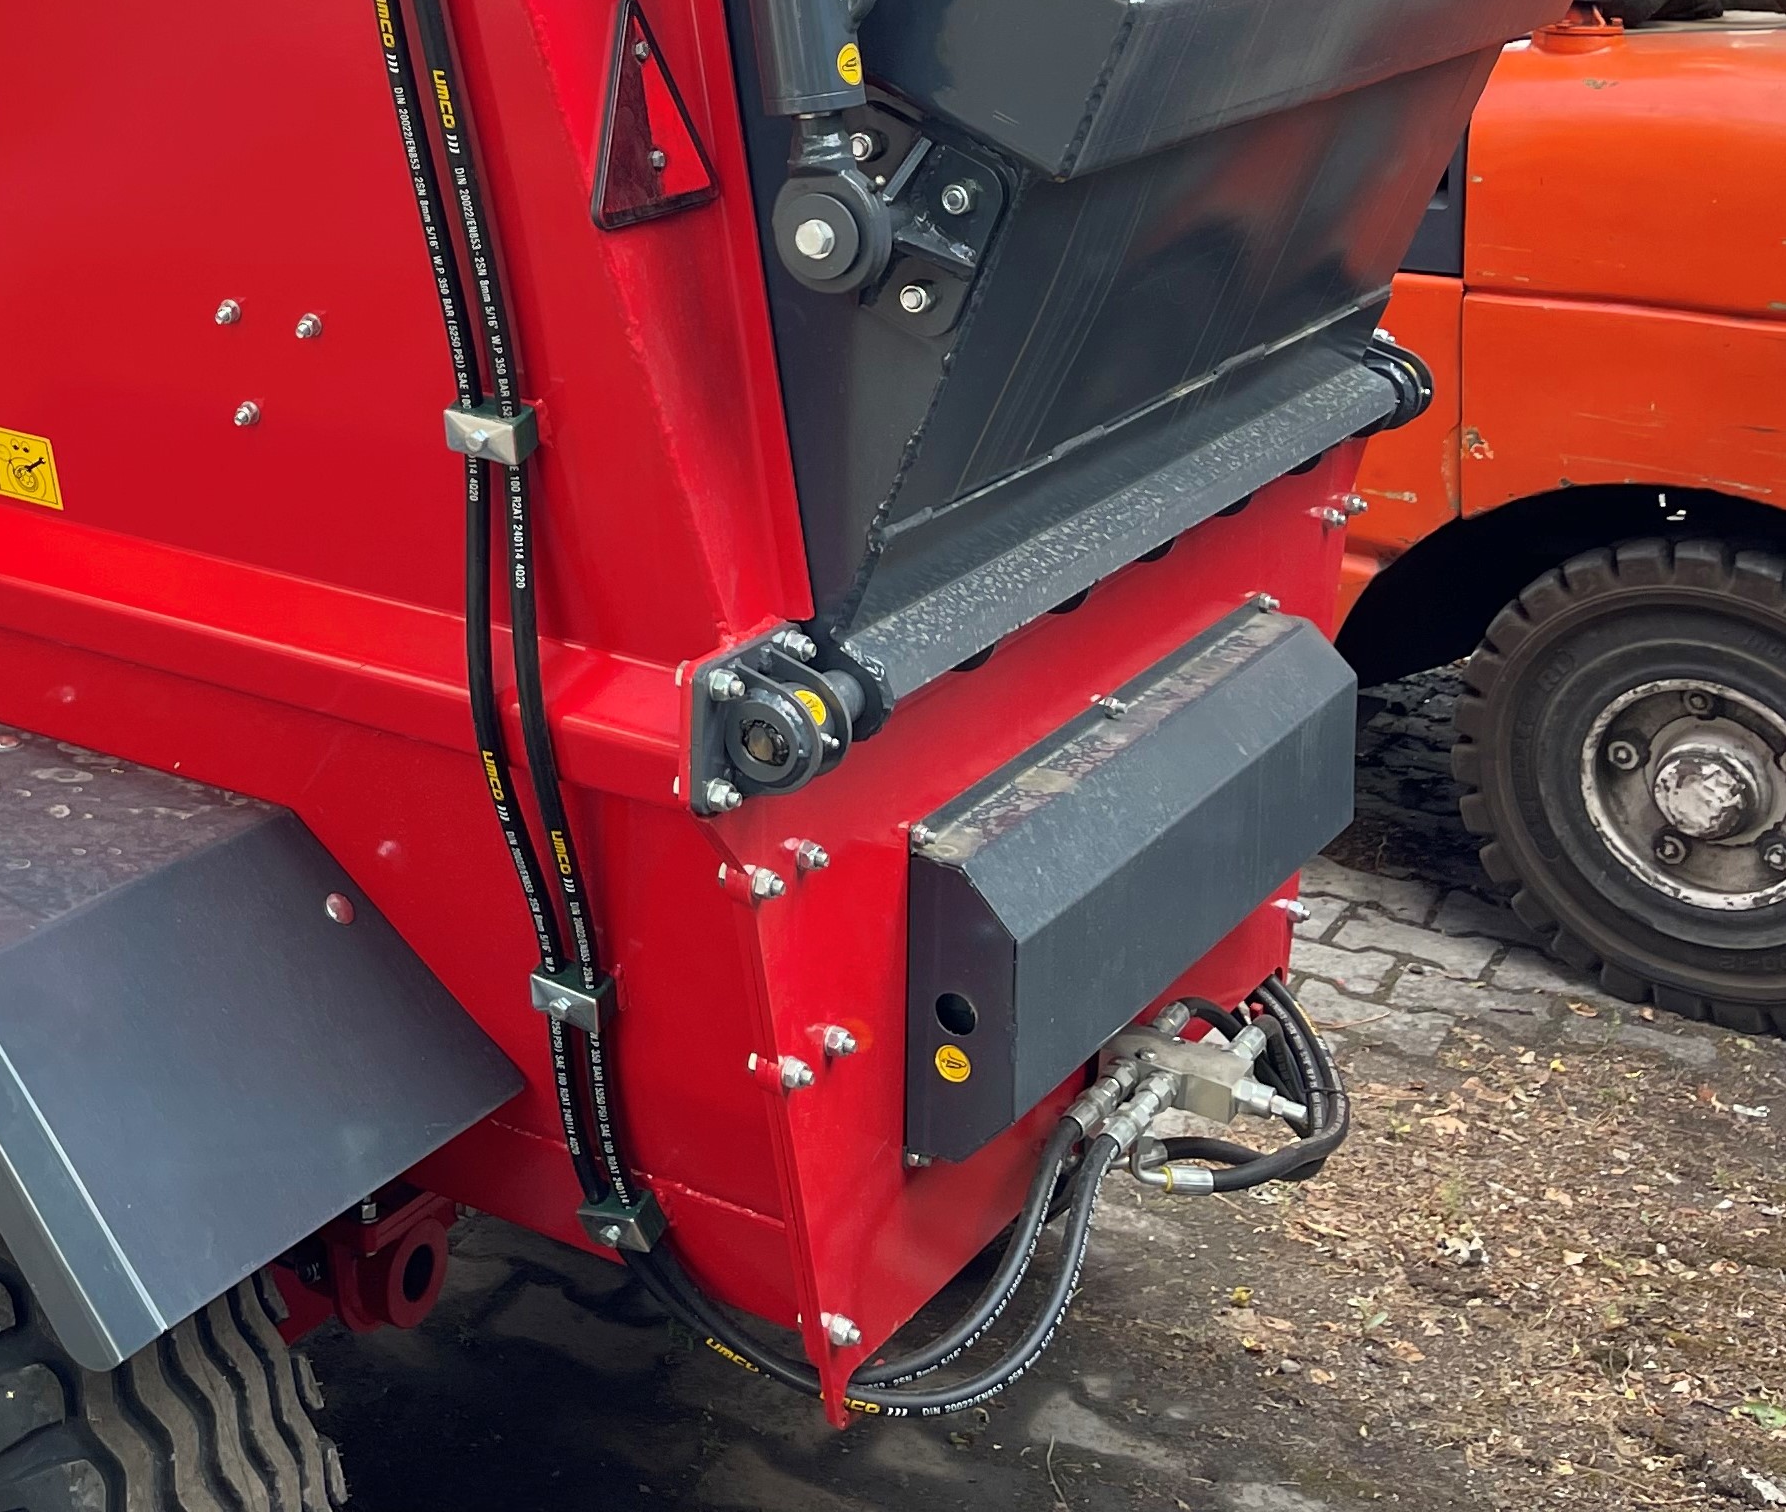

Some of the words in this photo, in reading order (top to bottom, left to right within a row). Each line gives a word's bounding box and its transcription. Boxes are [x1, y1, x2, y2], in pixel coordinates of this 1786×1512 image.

[394, 86, 406, 105] DIN
[454, 167, 467, 185] DIN
[437, 277, 449, 295] 350
[442, 298, 455, 317] BAR
[495, 357, 506, 375] 350
[457, 371, 469, 390] SAE
[498, 378, 510, 397] BAR
[509, 476, 521, 493] 100
[511, 496, 523, 521] R2AT
[513, 524, 525, 560] 240114
[590, 1049, 601, 1064] 350
[922, 1407, 941, 1417] DIN
